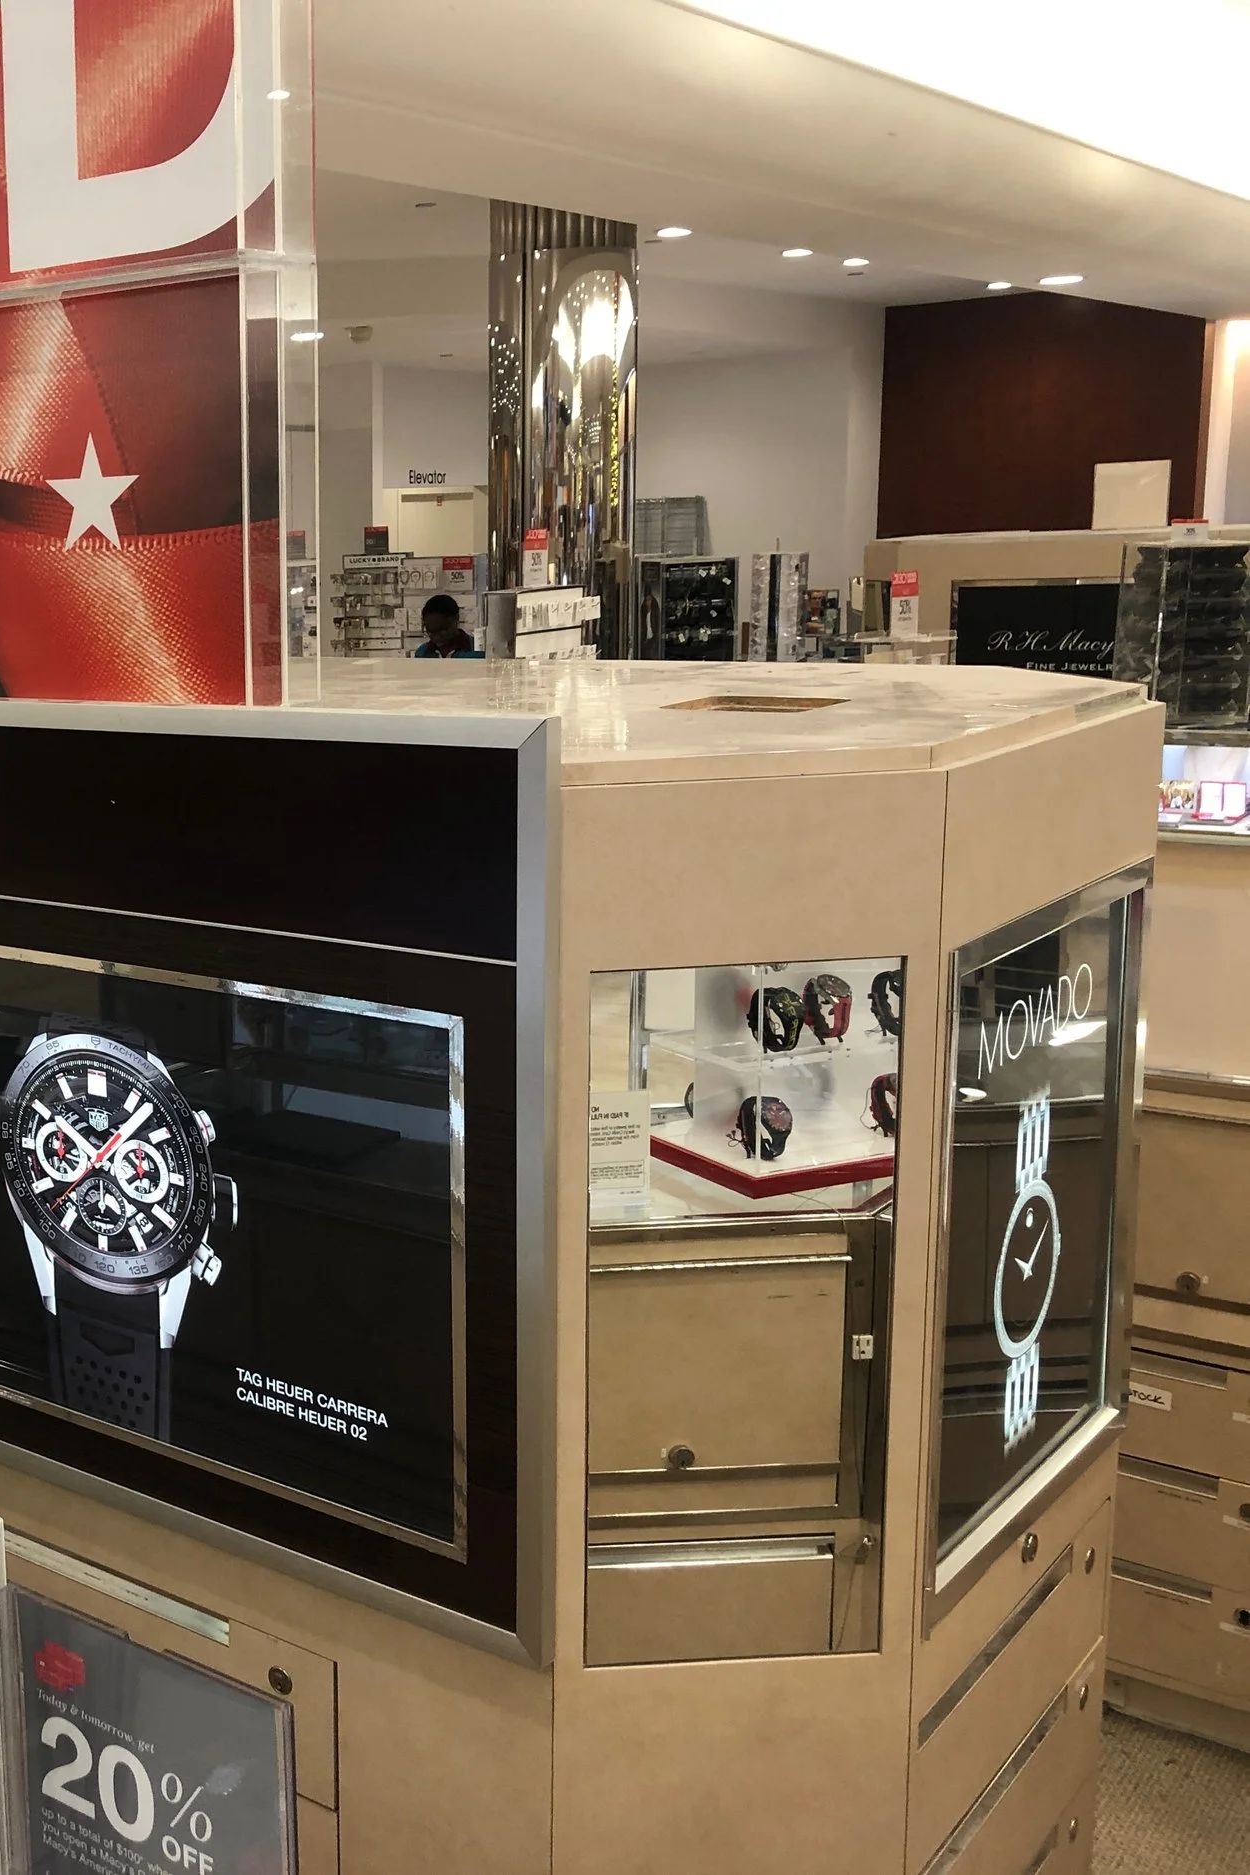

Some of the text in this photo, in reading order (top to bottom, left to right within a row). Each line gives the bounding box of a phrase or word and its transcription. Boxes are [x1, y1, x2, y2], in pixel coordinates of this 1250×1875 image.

[408, 470, 447, 485] Elevator
[451, 571, 465, 580] 50%
[1042, 628, 1114, 660] Macy
[978, 963, 1092, 1080] MOVADO
[18, 1061, 30, 1075] 70
[171, 1092, 190, 1118] 400
[190, 1126, 204, 1154] 300
[4, 1152, 15, 1170] 85
[13, 1179, 26, 1198] 90
[199, 1163, 209, 1193] 240
[193, 1199, 207, 1227] 200
[38, 1219, 57, 1240] 100
[177, 1232, 194, 1253] 170
[94, 1260, 116, 1274] 120
[128, 1263, 150, 1276] 135
[236, 1367, 388, 1428] TAG HEUER CARRERA
[236, 1387, 368, 1441] CALIBRE HEUER 02
[37, 1688, 67, 1713] Today
[70, 1704, 79, 1716] &
[138, 1740, 155, 1754] get
[42, 1806, 55, 1820] up
[57, 1813, 67, 1826] to
[69, 1821, 76, 1831] a
[79, 1824, 101, 1844] total
[103, 1839, 113, 1850] of
[42, 1820, 60, 1837] you
[63, 1831, 88, 1851] open
[90, 1846, 97, 1856] a
[162, 1835, 214, 1875] OFF
